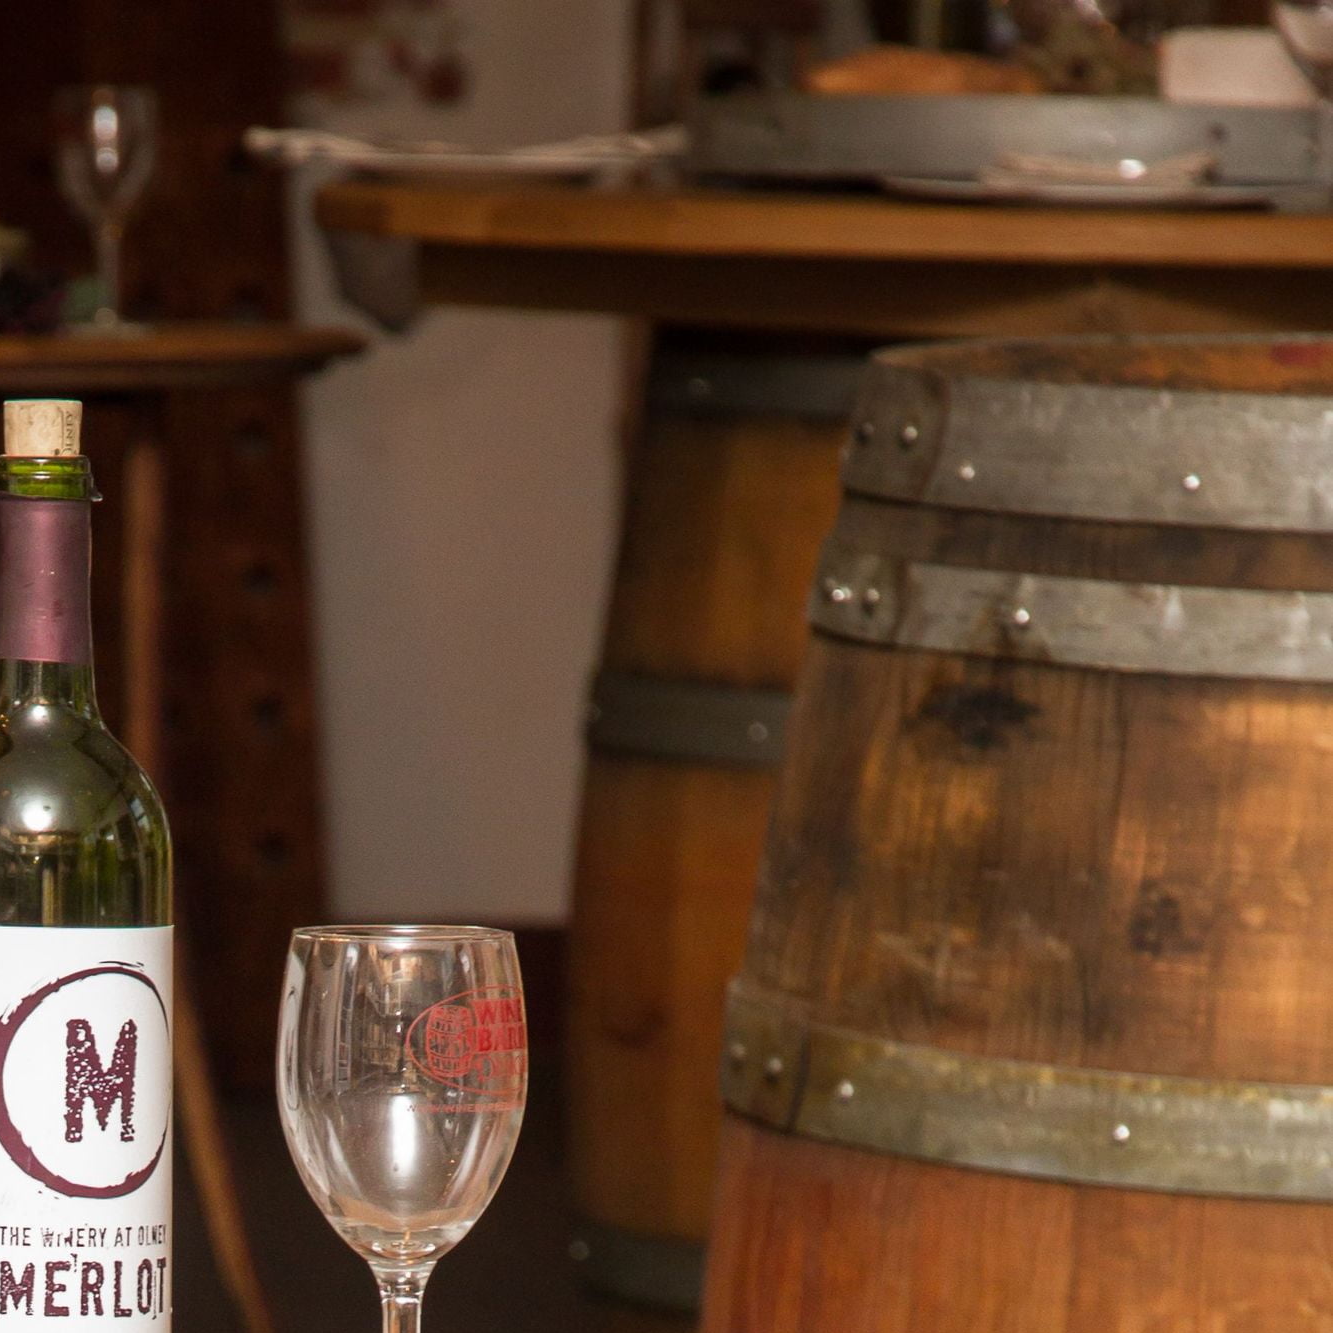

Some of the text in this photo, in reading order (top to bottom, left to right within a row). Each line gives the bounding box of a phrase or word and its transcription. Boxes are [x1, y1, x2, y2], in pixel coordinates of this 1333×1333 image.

[64, 1018, 137, 1143] M
[0, 1226, 32, 1246] THE
[113, 1227, 133, 1247] AT
[0, 1257, 167, 1319] MERLOT
